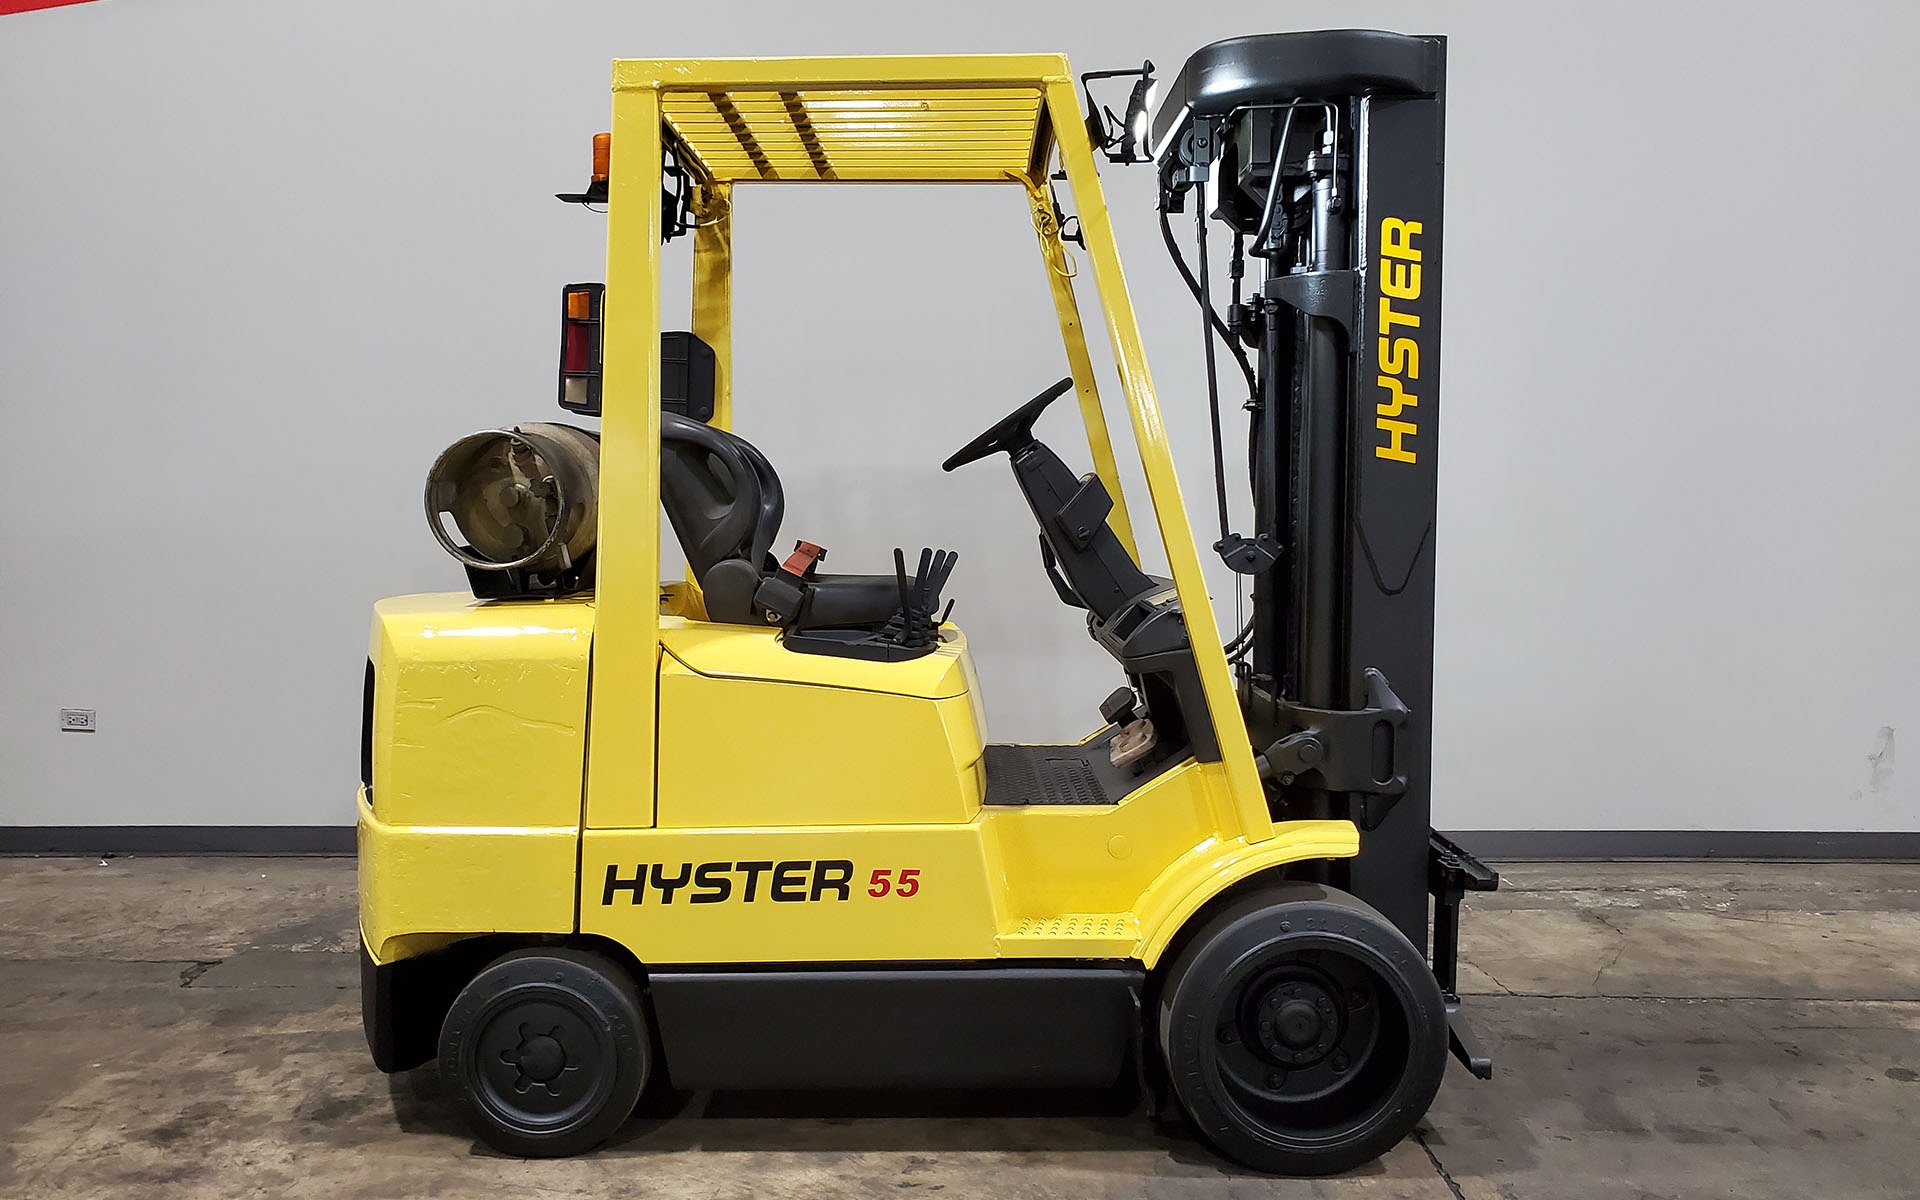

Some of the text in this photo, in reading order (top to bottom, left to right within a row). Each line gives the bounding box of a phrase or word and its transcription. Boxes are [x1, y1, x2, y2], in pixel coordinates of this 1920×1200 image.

[1376, 217, 1422, 463] HYSTER
[602, 860, 920, 905] HYSTER 55
